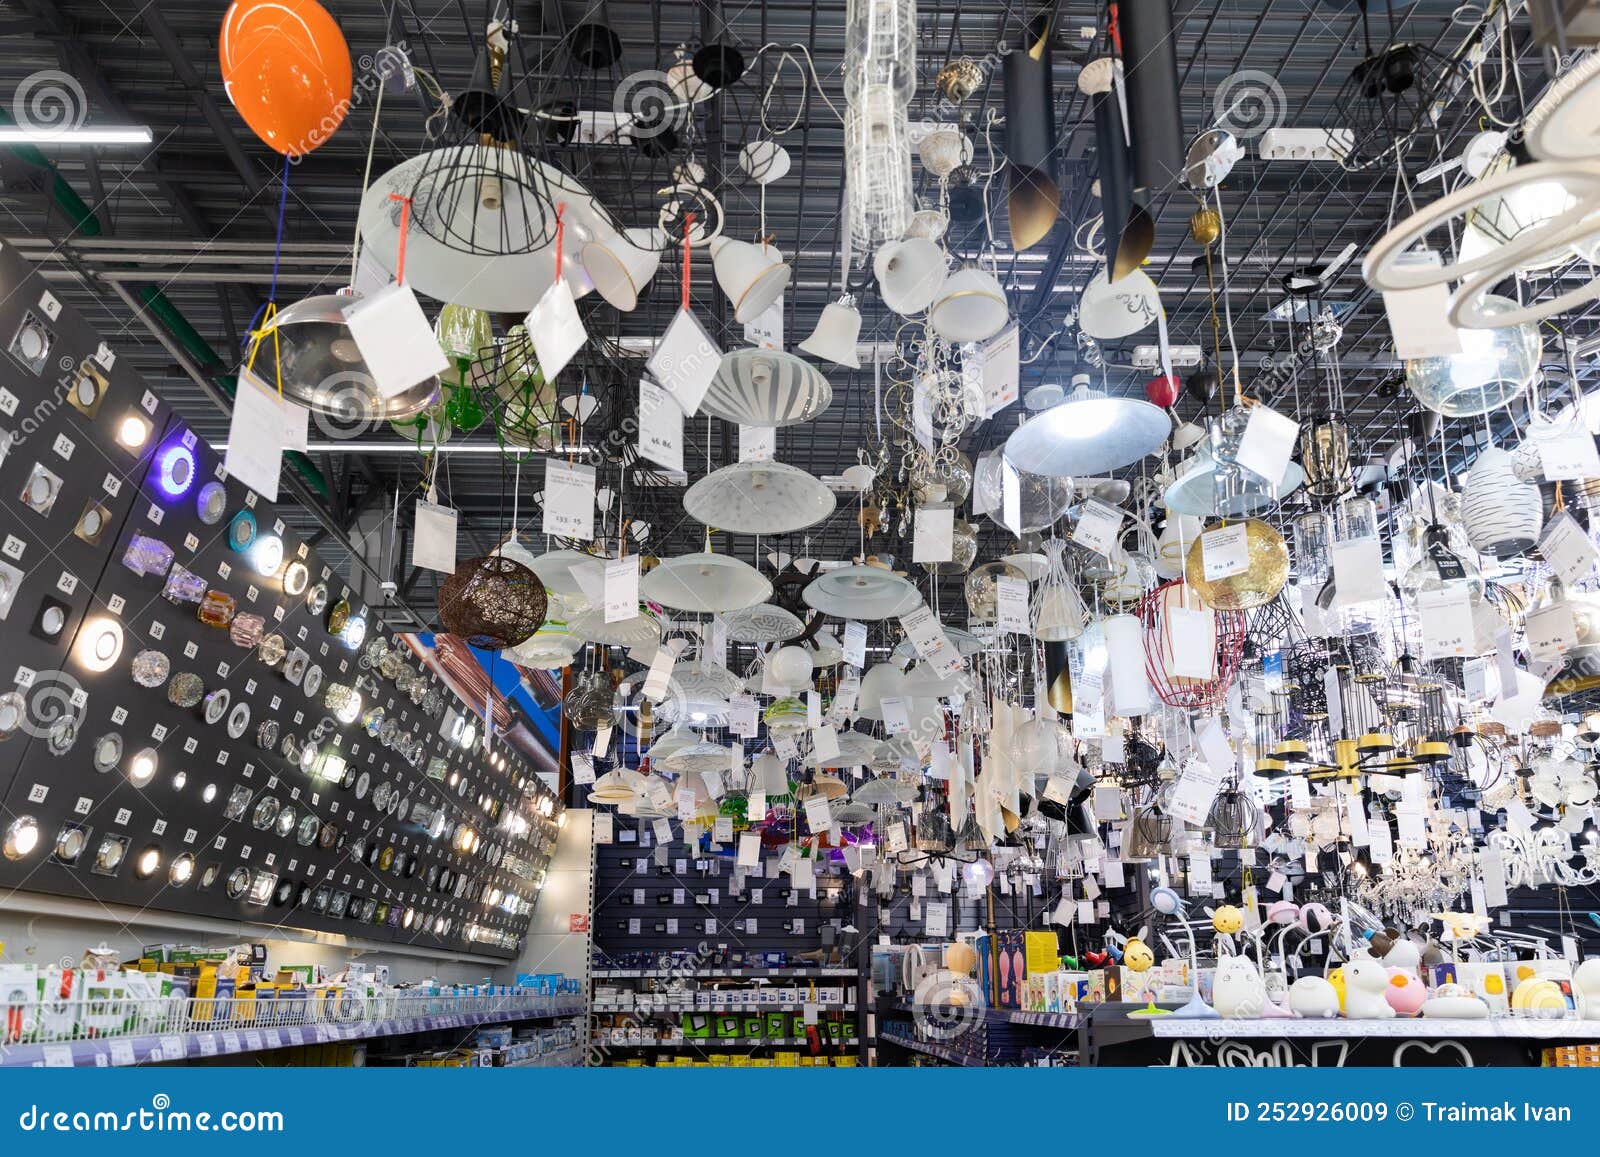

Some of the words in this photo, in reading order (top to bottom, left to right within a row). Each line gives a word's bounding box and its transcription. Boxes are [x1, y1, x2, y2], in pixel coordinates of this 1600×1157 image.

[59, 440, 71, 454] 15
[107, 478, 118, 491] 16
[8, 541, 20, 554] 23
[62, 576, 73, 589] 24
[34, 788, 44, 799] 33
[79, 801, 89, 811] 34
[119, 811, 129, 822] 35
